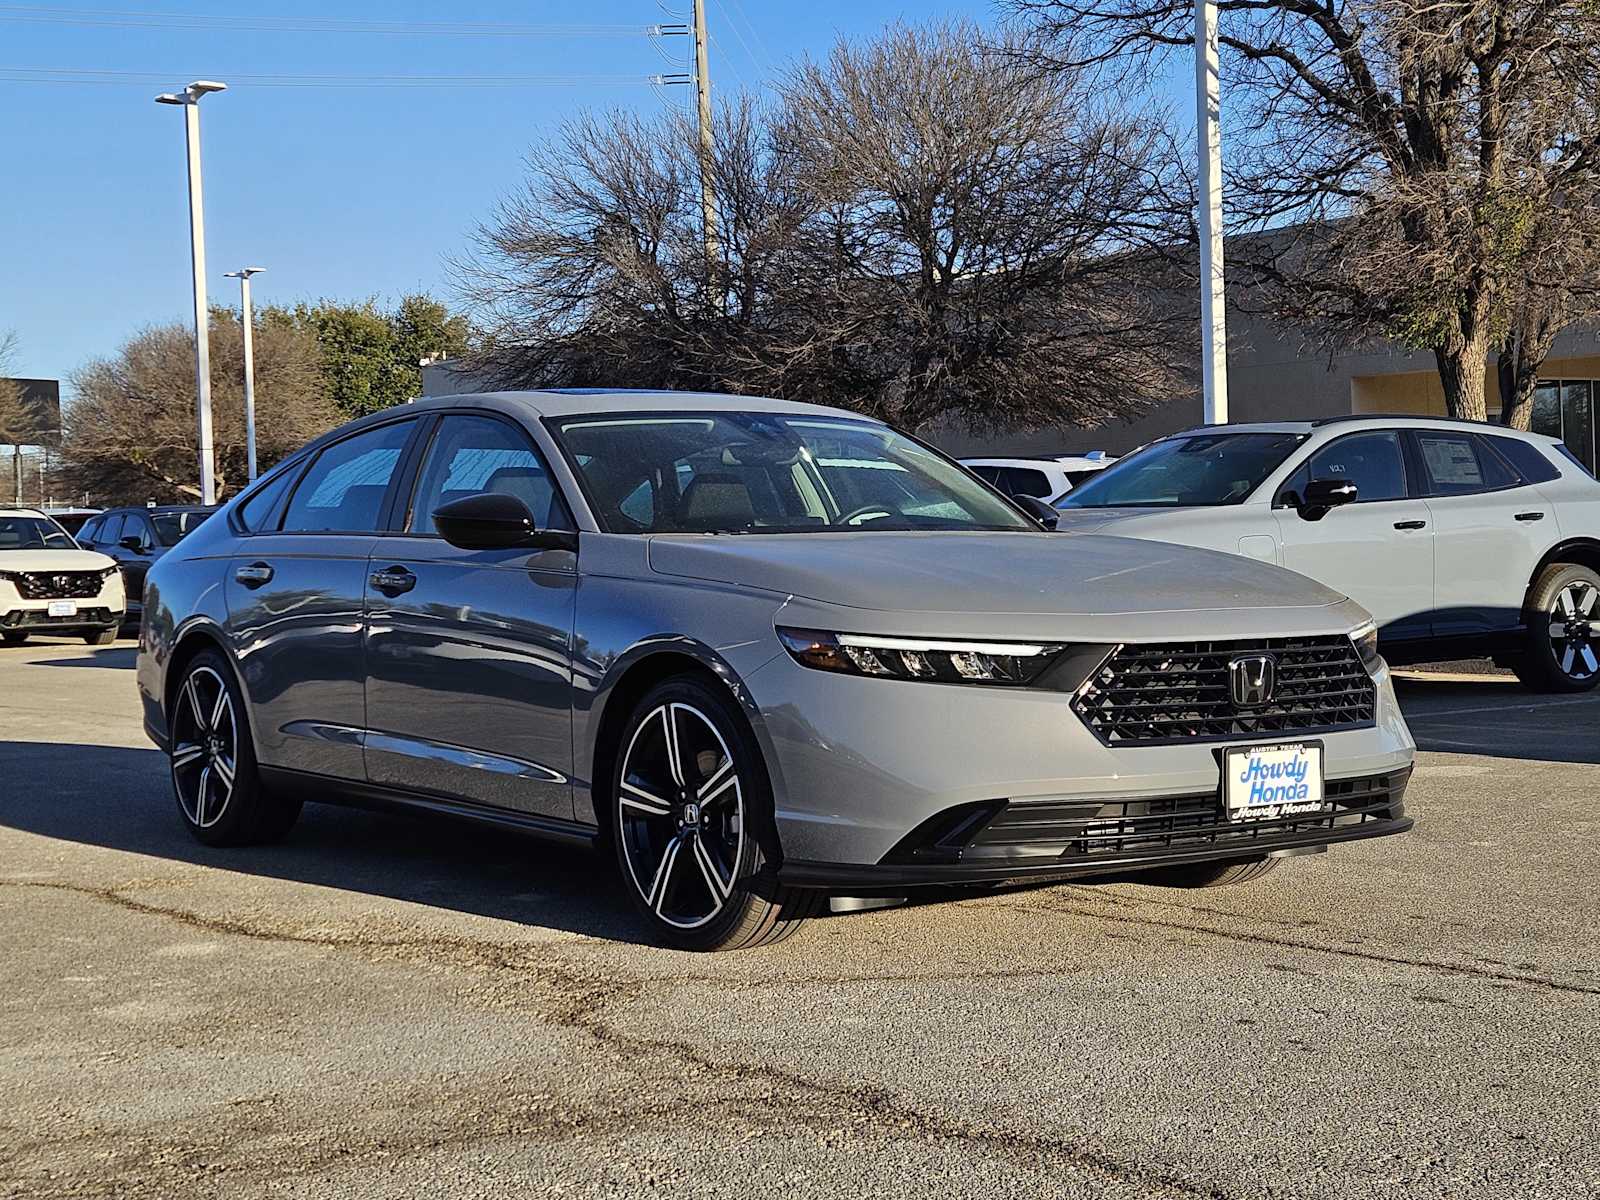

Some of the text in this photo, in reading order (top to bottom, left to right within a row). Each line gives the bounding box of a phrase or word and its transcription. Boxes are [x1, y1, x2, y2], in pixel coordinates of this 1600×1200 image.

[1240, 754, 1309, 783] Howdy
[1248, 781, 1309, 804] Honda
[1232, 801, 1322, 820] Howdy Honda
